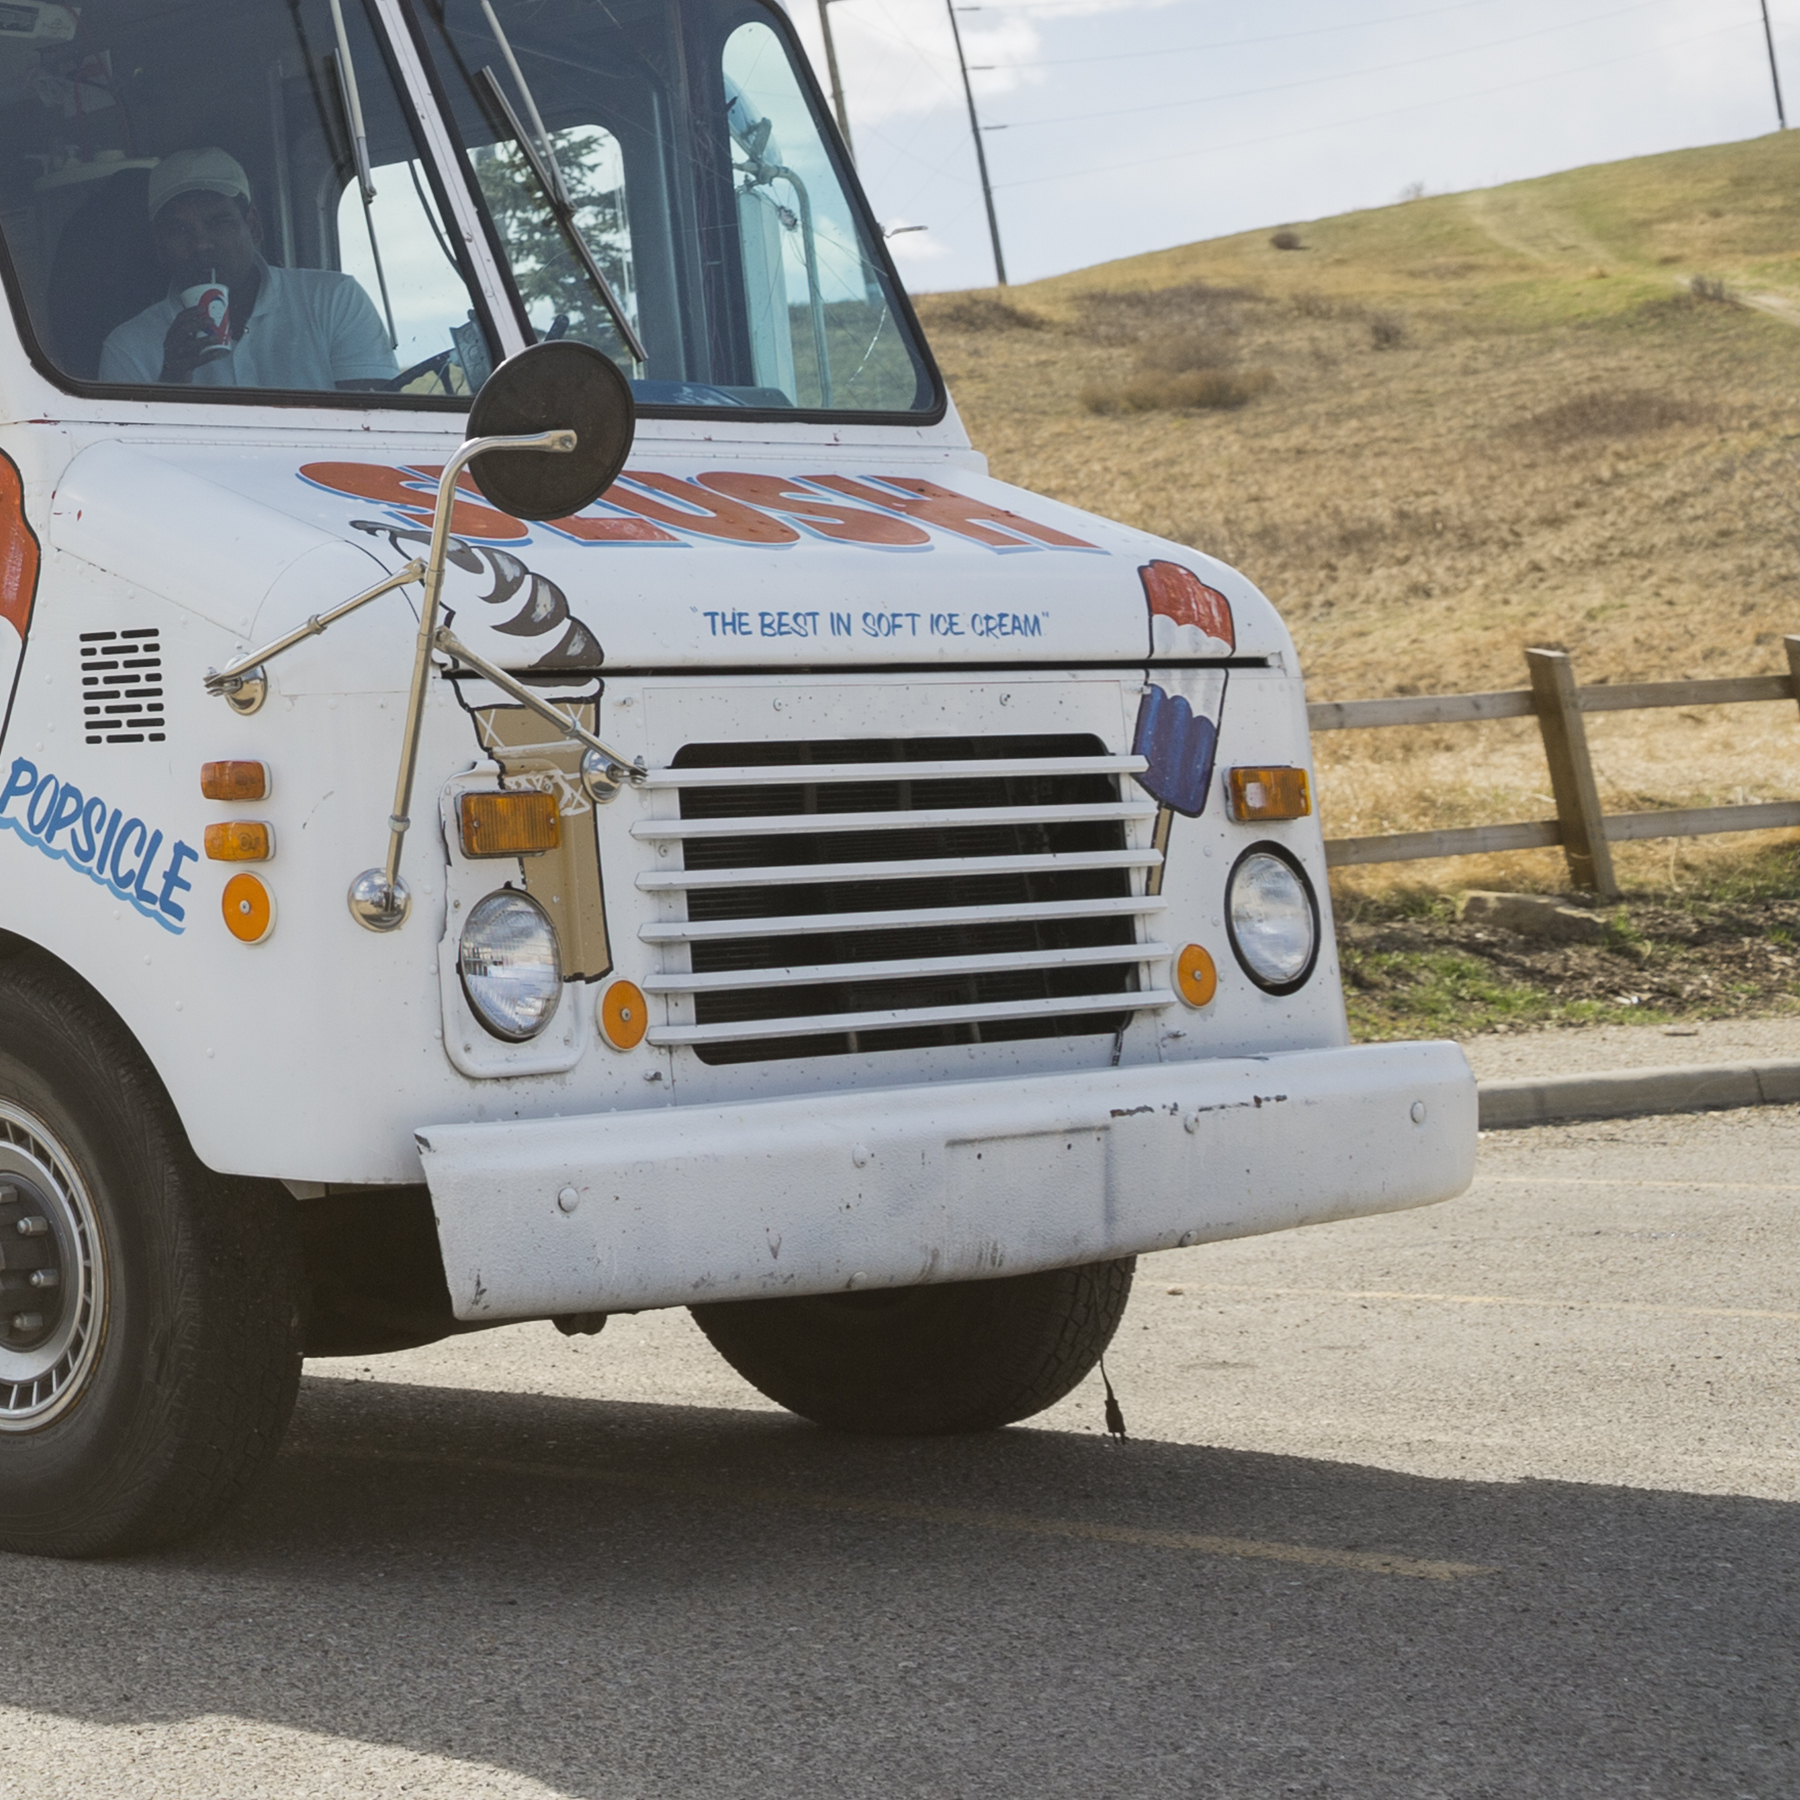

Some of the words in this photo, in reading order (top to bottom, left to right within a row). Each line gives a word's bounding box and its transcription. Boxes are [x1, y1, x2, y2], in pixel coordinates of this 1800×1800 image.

[759, 611, 820, 638] BEST
[829, 611, 852, 637] IN
[861, 611, 921, 638] SOFT
[929, 612, 965, 637] ICE
